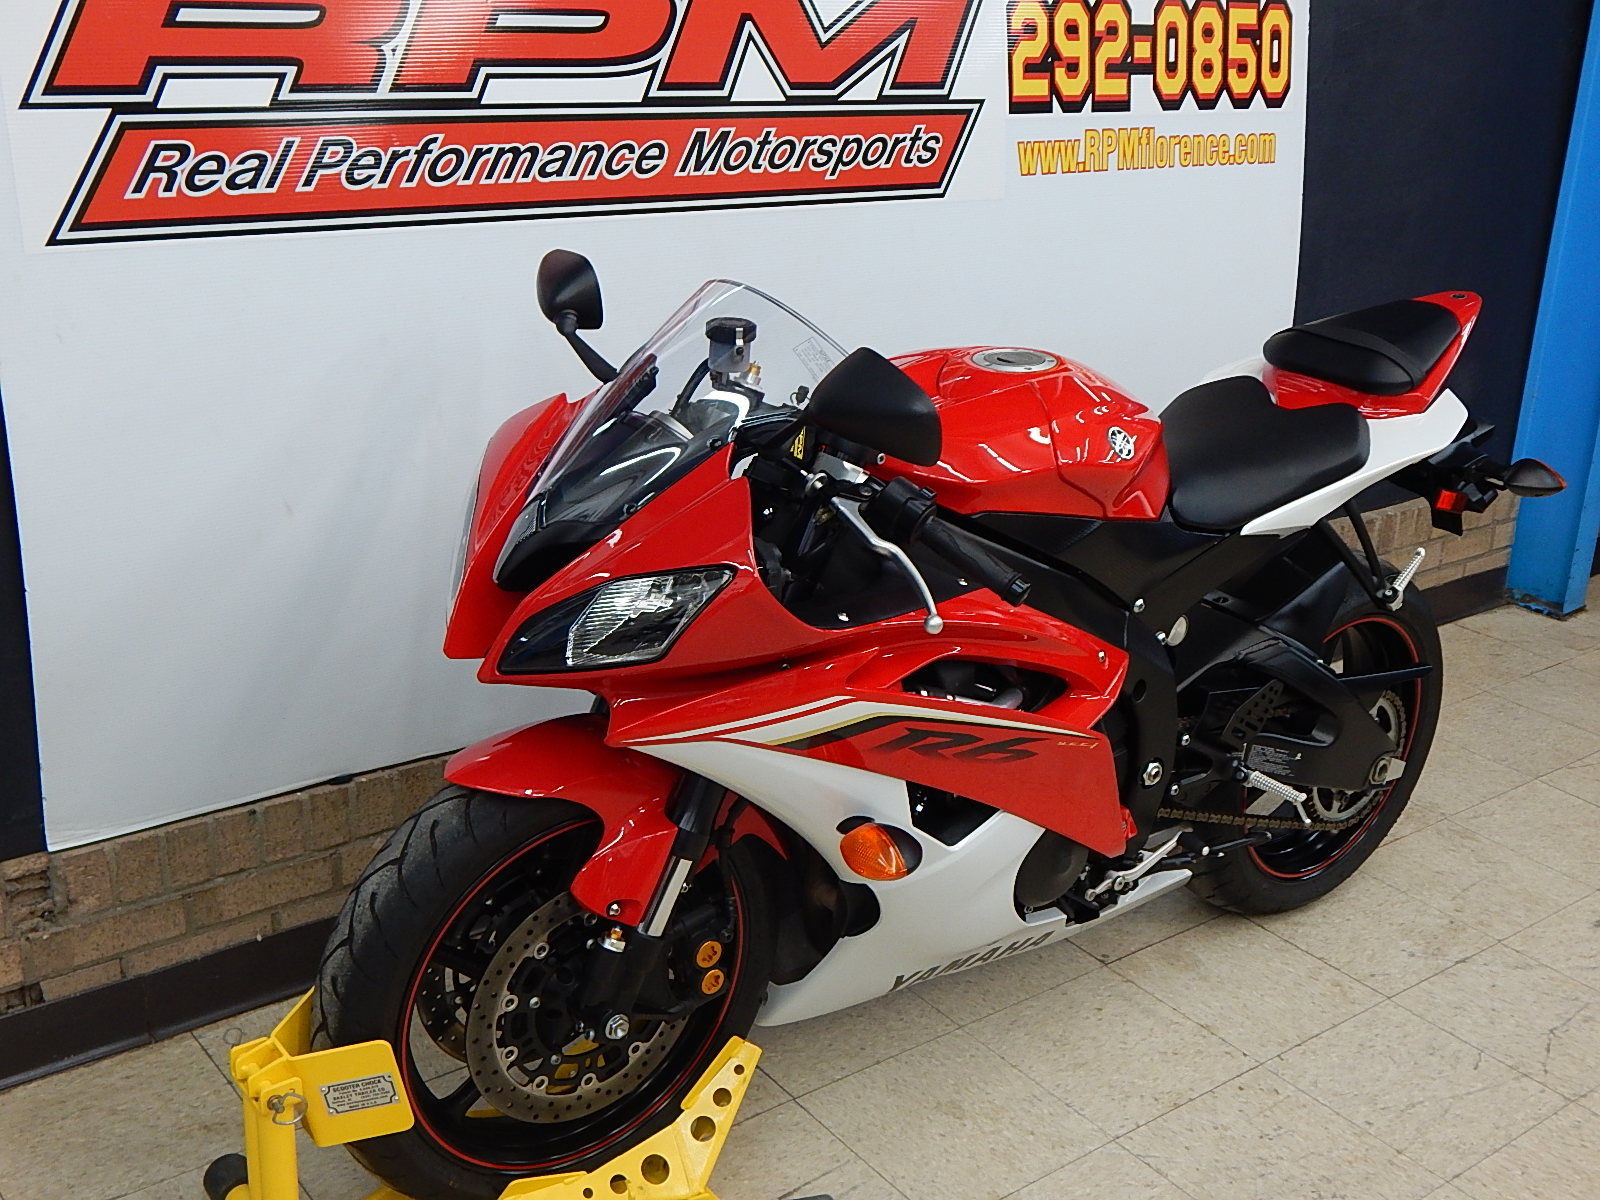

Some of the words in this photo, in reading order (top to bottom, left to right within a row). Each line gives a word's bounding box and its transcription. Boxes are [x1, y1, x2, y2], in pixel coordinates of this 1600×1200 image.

[35, 0, 975, 100] RPM
[1007, 0, 1293, 113] 292-0850
[124, 137, 301, 199] Real
[295, 129, 667, 193] Performance
[674, 124, 943, 180] Motorsports
[1017, 127, 1277, 176] www.RPMflorence.com
[868, 727, 1050, 764] R6
[888, 930, 1056, 992] YAMAHA
